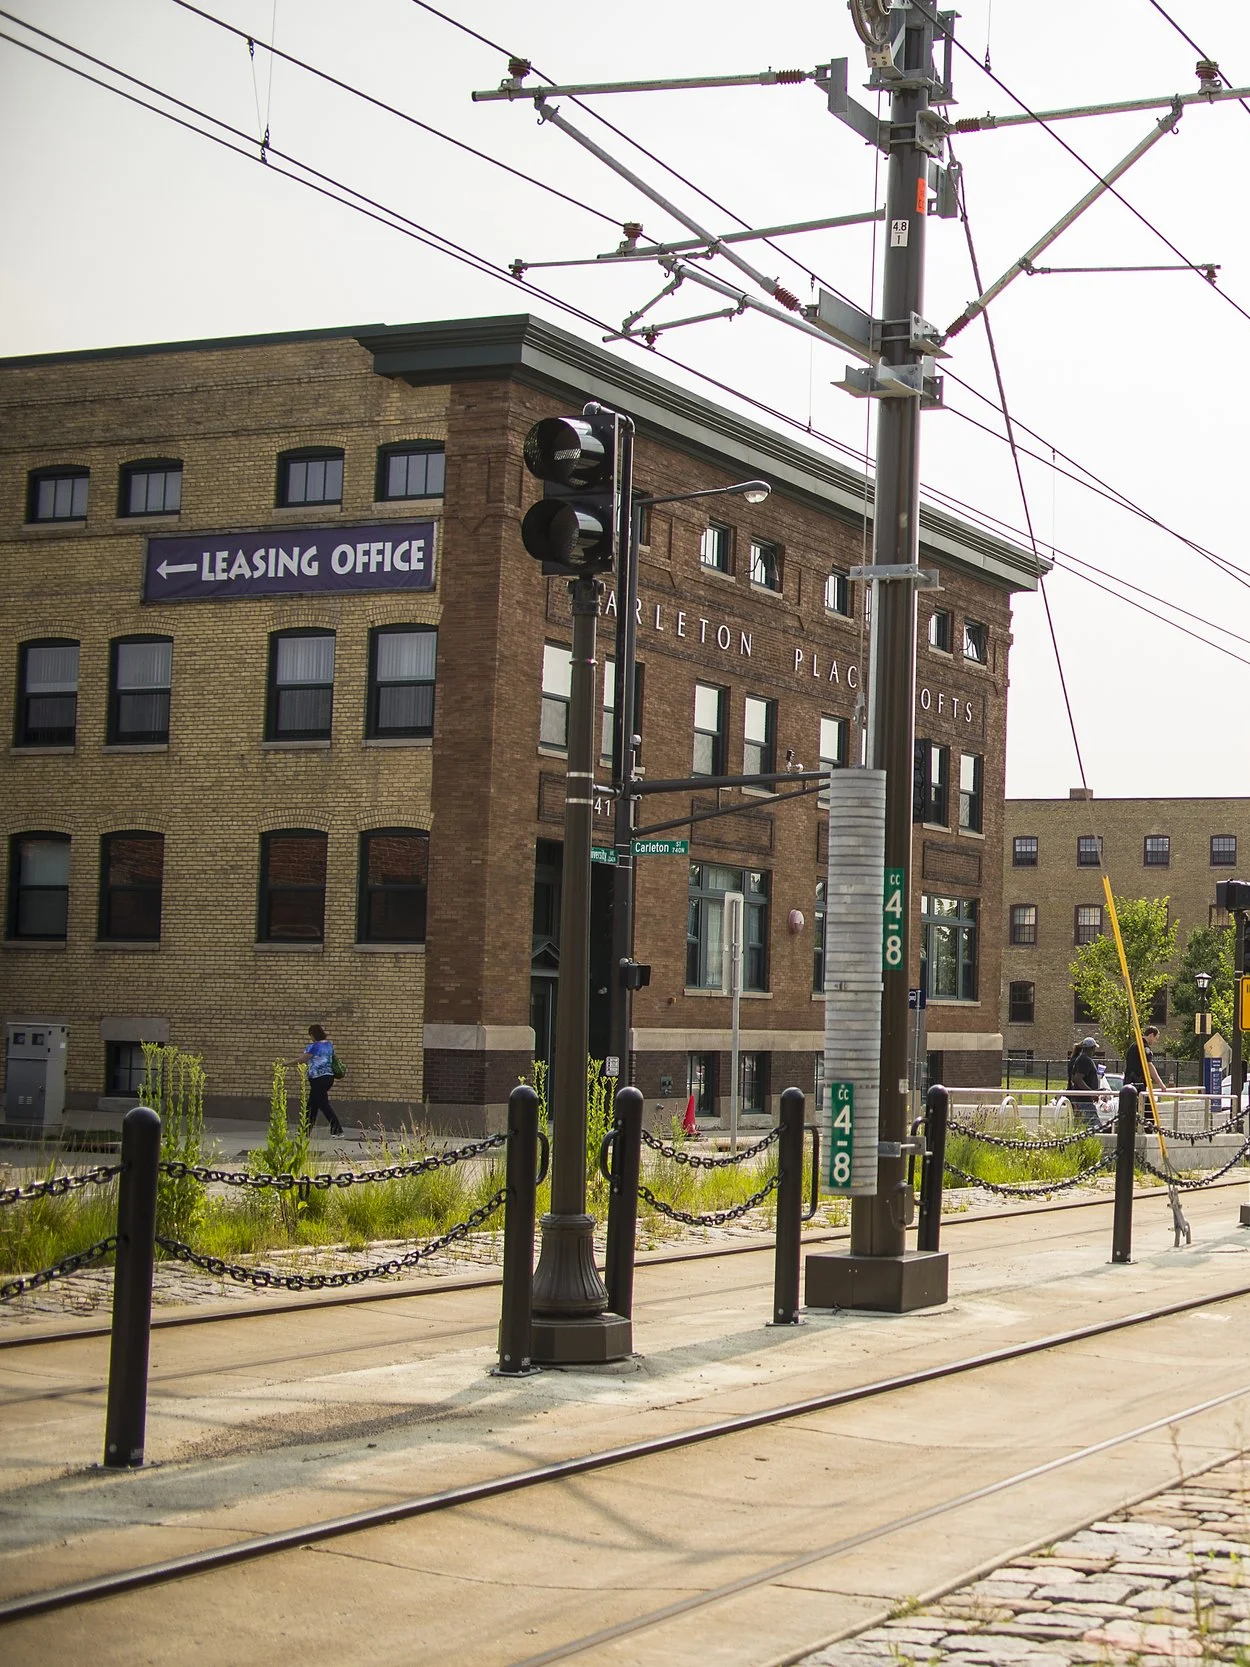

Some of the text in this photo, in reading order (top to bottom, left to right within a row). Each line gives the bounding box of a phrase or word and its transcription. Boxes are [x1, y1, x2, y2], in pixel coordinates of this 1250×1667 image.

[892, 221, 907, 232] 4.8
[201, 539, 425, 581] LEASING OFFICE
[604, 590, 973, 723] ARLETON PLAC OFTS
[635, 842, 669, 853] Carleton
[889, 873, 901, 886] CC
[838, 1088, 850, 1101] CC
